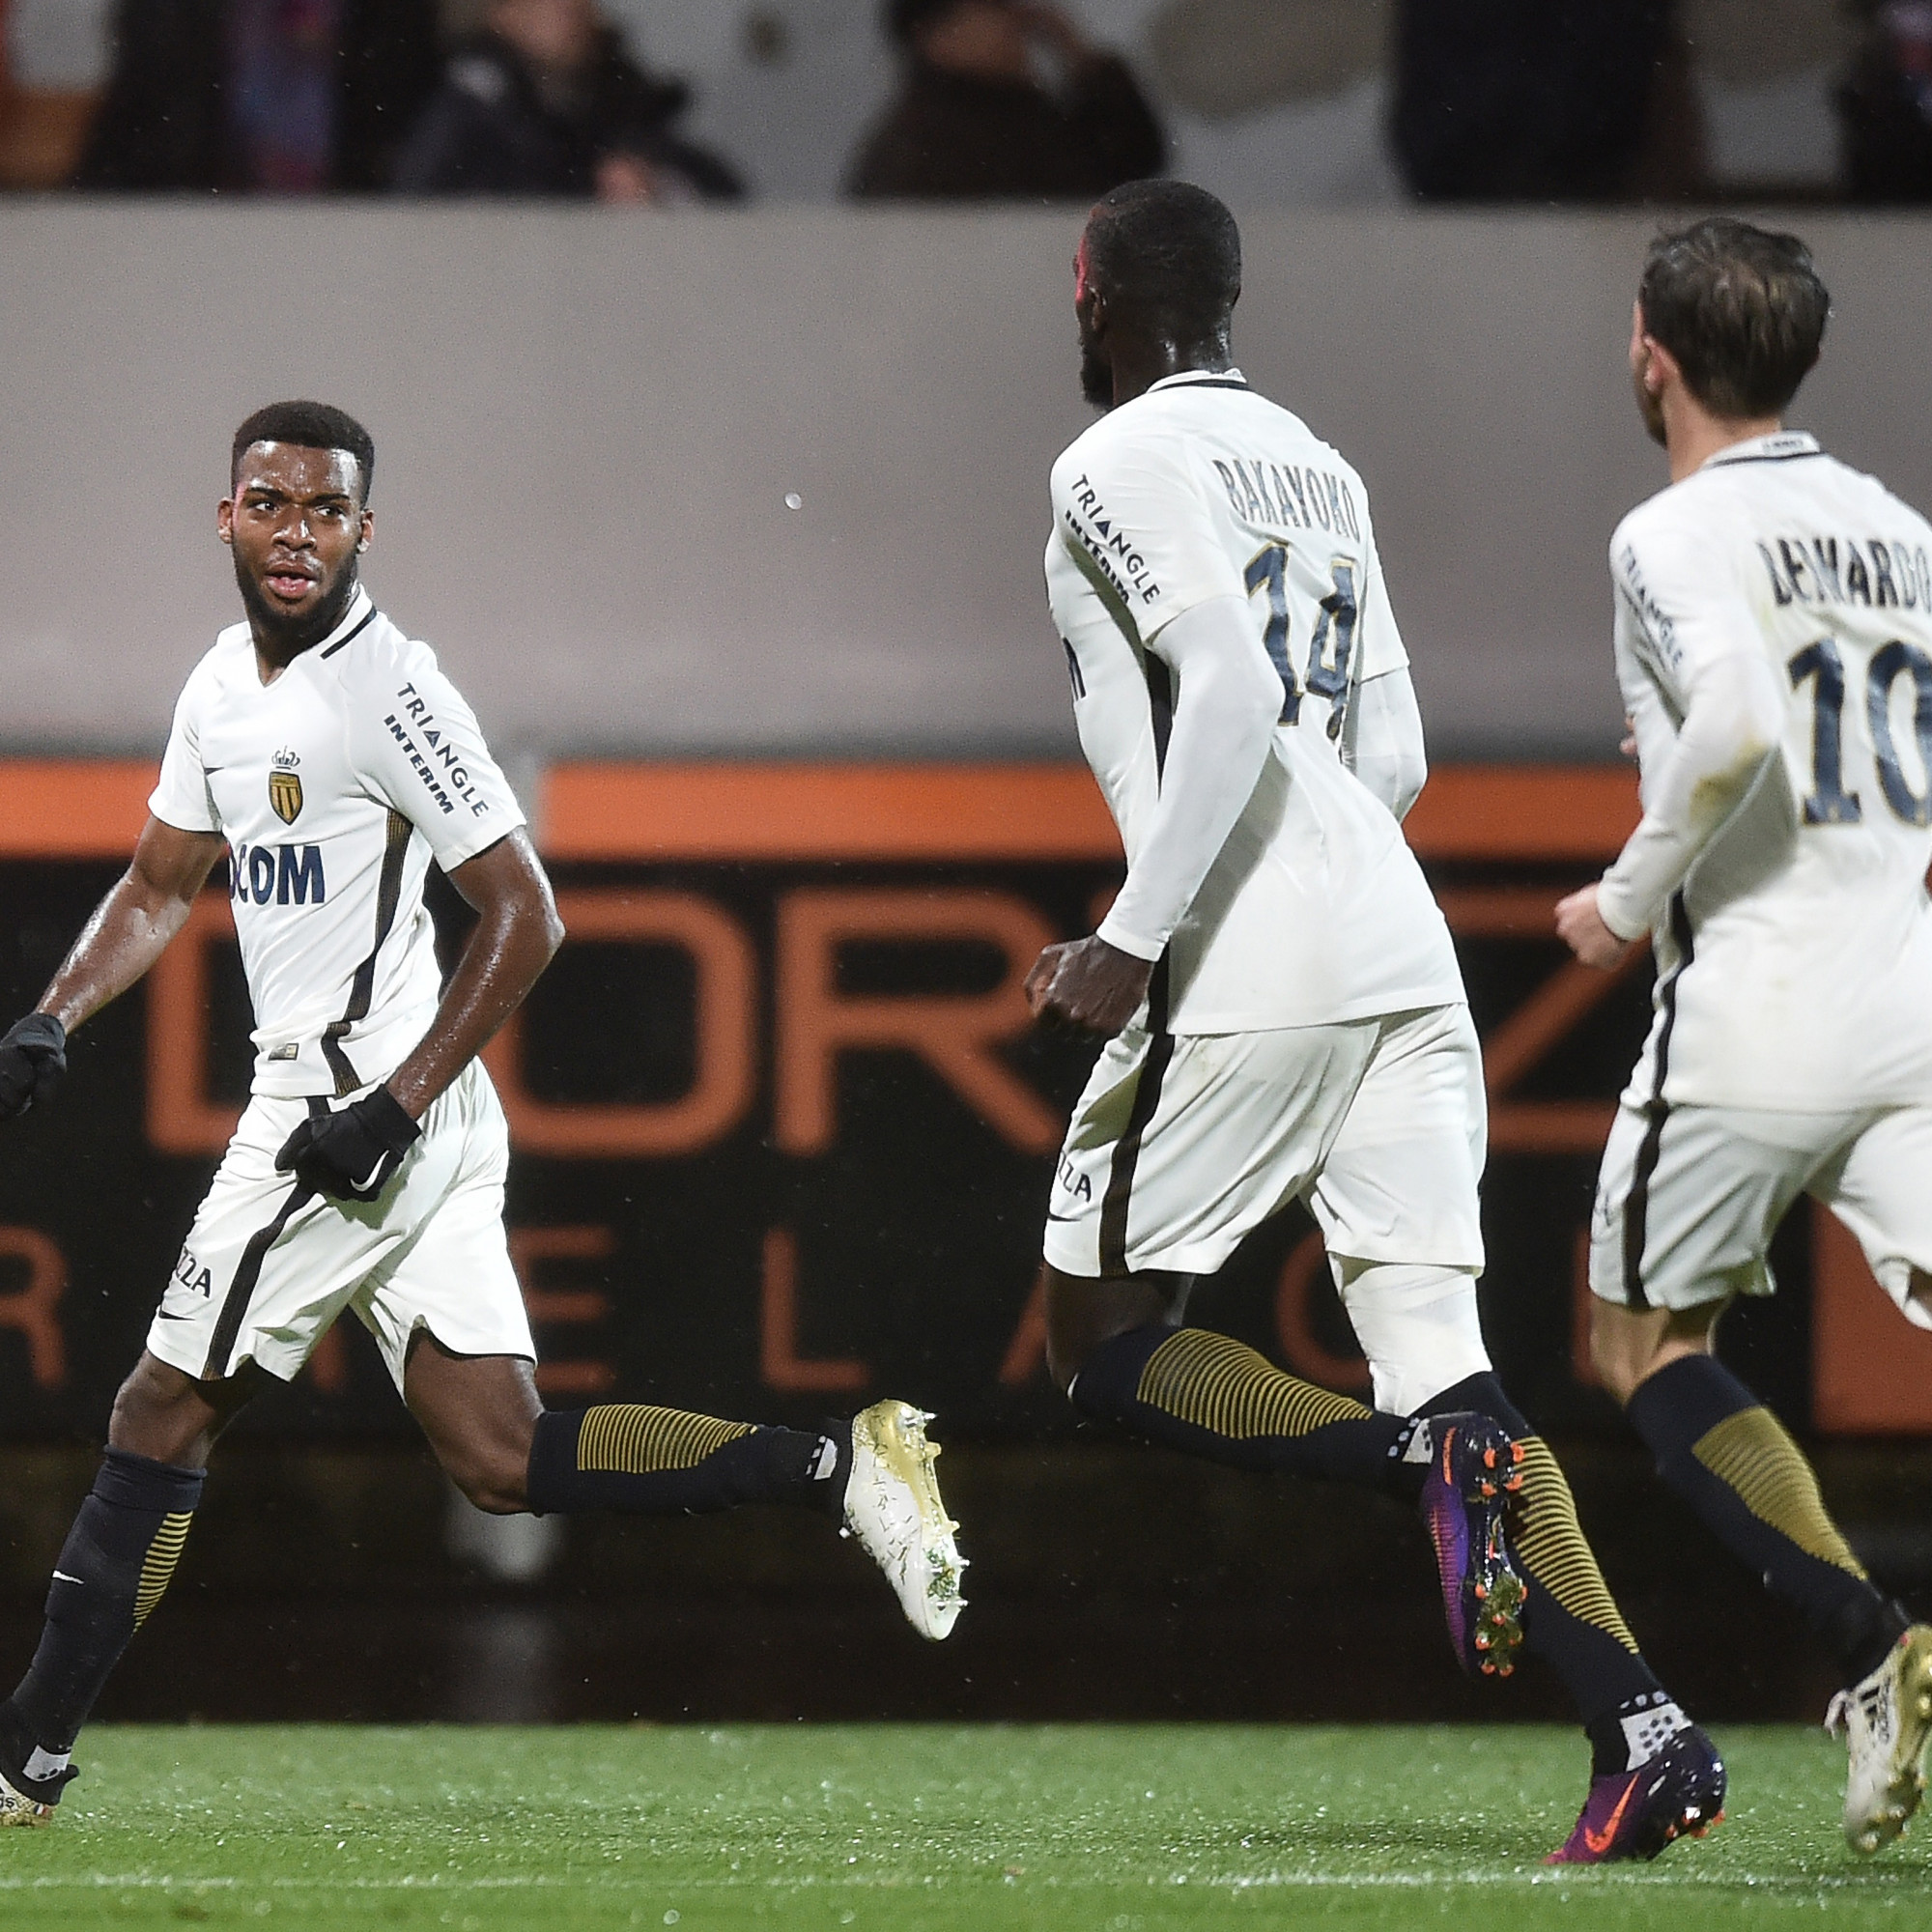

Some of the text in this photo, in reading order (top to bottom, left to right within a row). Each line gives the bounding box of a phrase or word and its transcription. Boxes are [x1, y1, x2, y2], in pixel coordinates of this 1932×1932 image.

[1071, 473, 1161, 605] TRIANGLE
[1212, 459, 1360, 544] BAKAYOKO
[1242, 541, 1358, 744] 14
[384, 714, 455, 815] INTERIM
[397, 682, 489, 817] TRIANGLE
[1787, 637, 1932, 829] 10
[228, 843, 325, 905] COM
